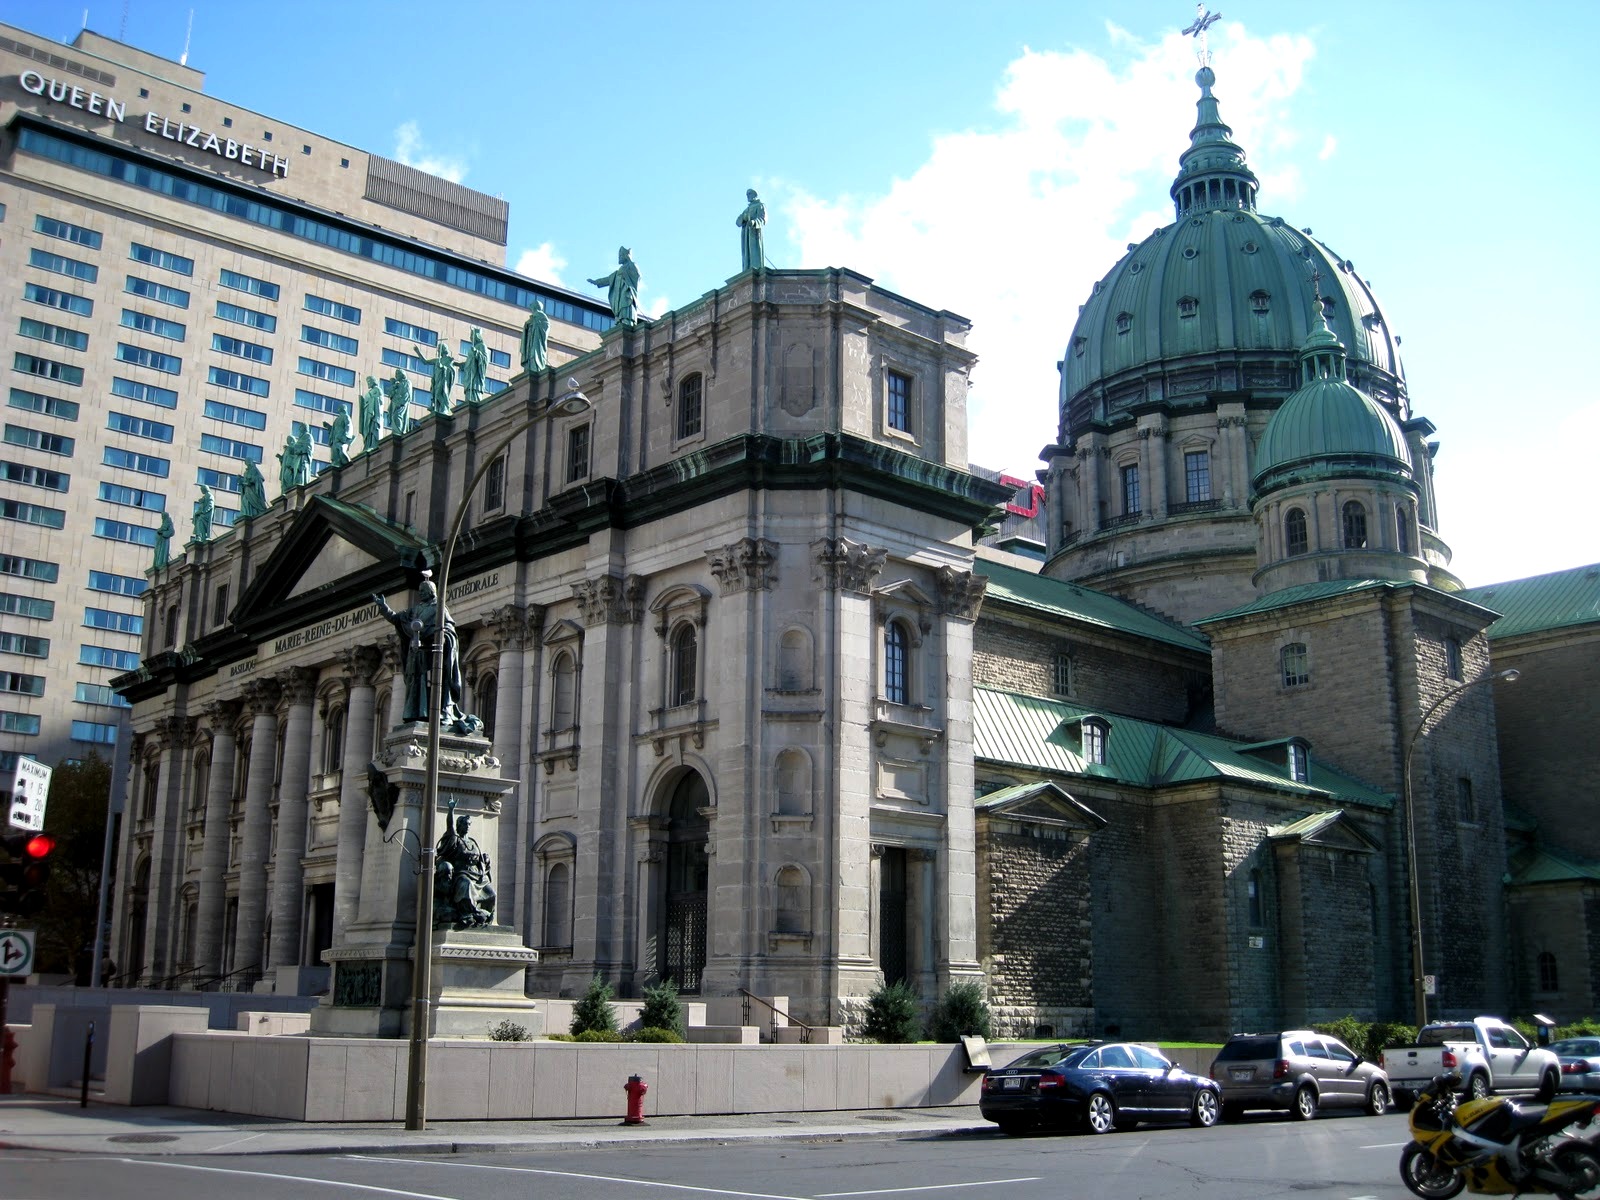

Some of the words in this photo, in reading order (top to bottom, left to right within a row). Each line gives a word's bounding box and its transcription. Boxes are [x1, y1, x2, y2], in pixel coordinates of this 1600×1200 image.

[19, 70, 126, 123] QUEEN
[145, 111, 290, 178] ELIZABETH
[274, 604, 381, 655] MARIE-REINE-DU-MOND
[21, 761, 48, 779] MAXIMUM
